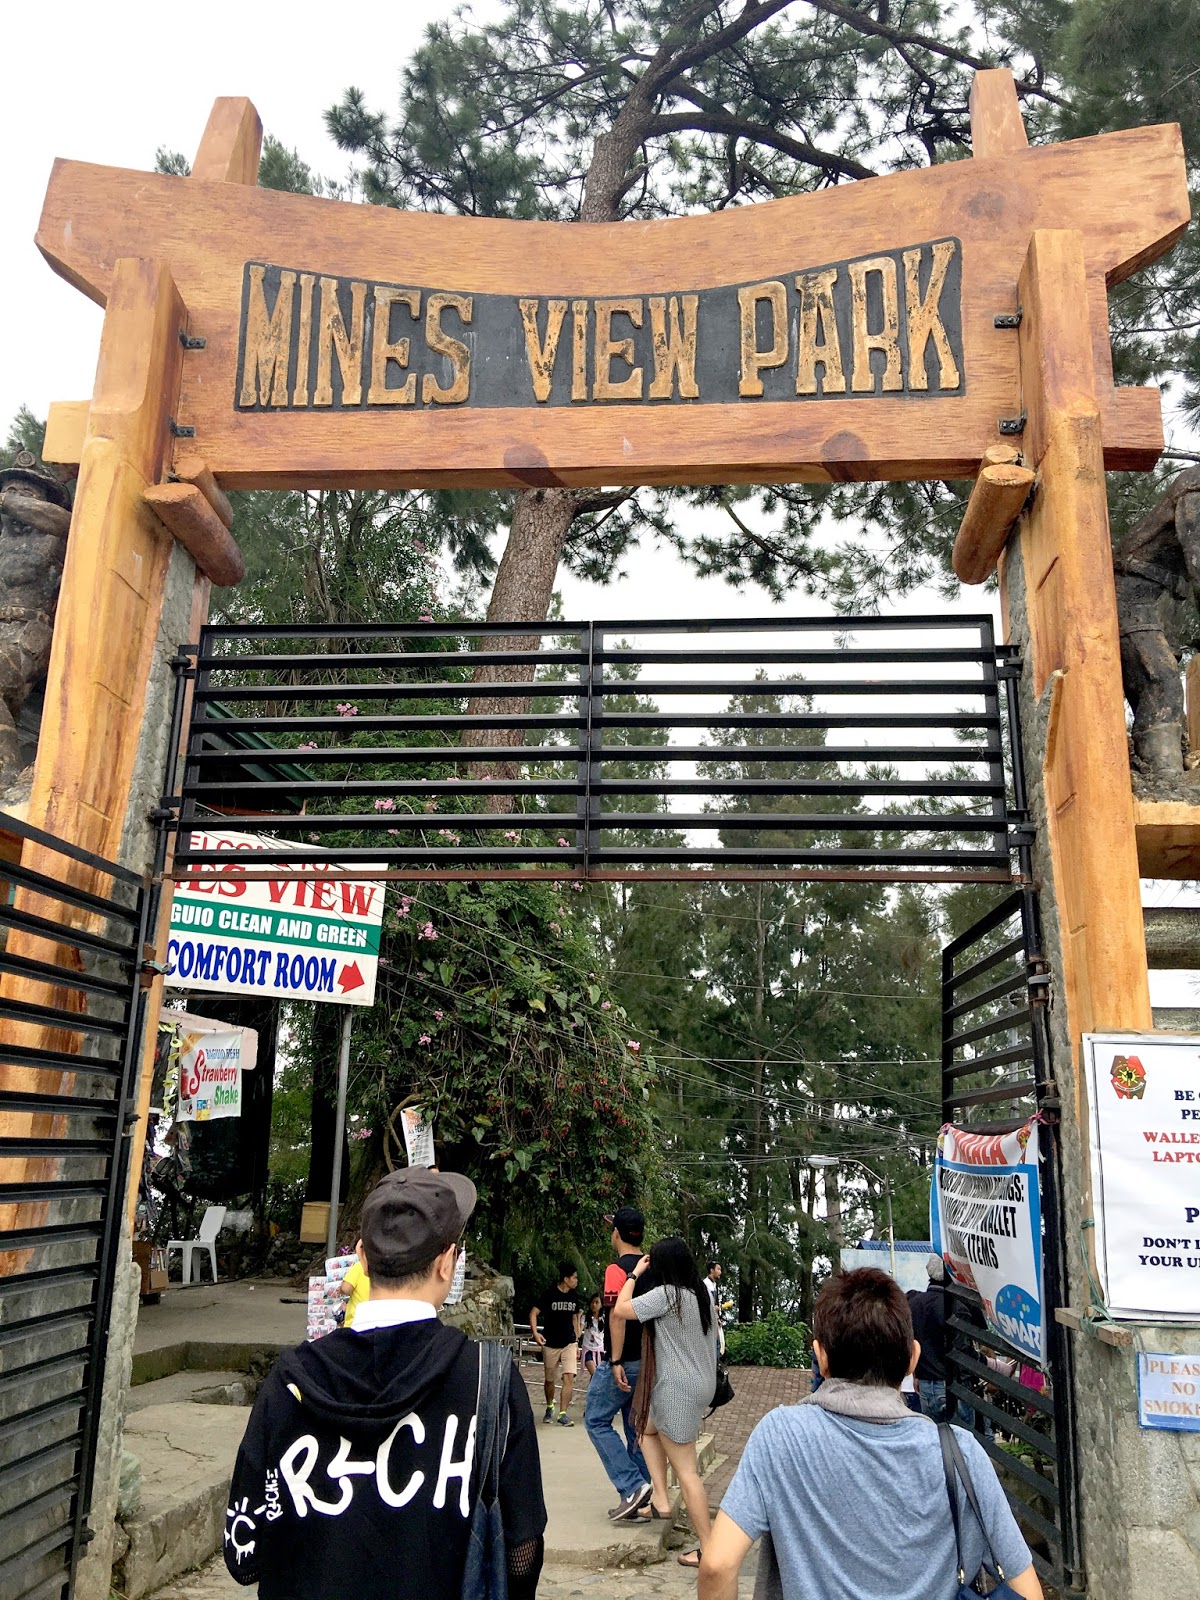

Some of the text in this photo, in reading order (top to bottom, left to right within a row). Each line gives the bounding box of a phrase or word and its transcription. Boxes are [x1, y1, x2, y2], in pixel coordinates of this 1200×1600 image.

[240, 241, 960, 407] MINES VIEW PARK
[264, 879, 377, 916] VIEW
[218, 909, 272, 934] CLEAN
[276, 918, 313, 940] AND
[316, 923, 368, 948] GREEN
[165, 938, 337, 993] COMFORT ROOM
[189, 1049, 238, 1096] Strawberry
[214, 1085, 239, 1106] Shake
[1174, 1089, 1195, 1101] BE
[1143, 1131, 1200, 1144] WALLE
[1184, 1206, 1200, 1223] P
[967, 1232, 999, 1270] ITEMS
[1142, 1237, 1192, 1249] DON'T
[1138, 1255, 1200, 1268] YOUR U
[551, 1301, 577, 1312] GUESS
[1171, 1381, 1196, 1396] NO
